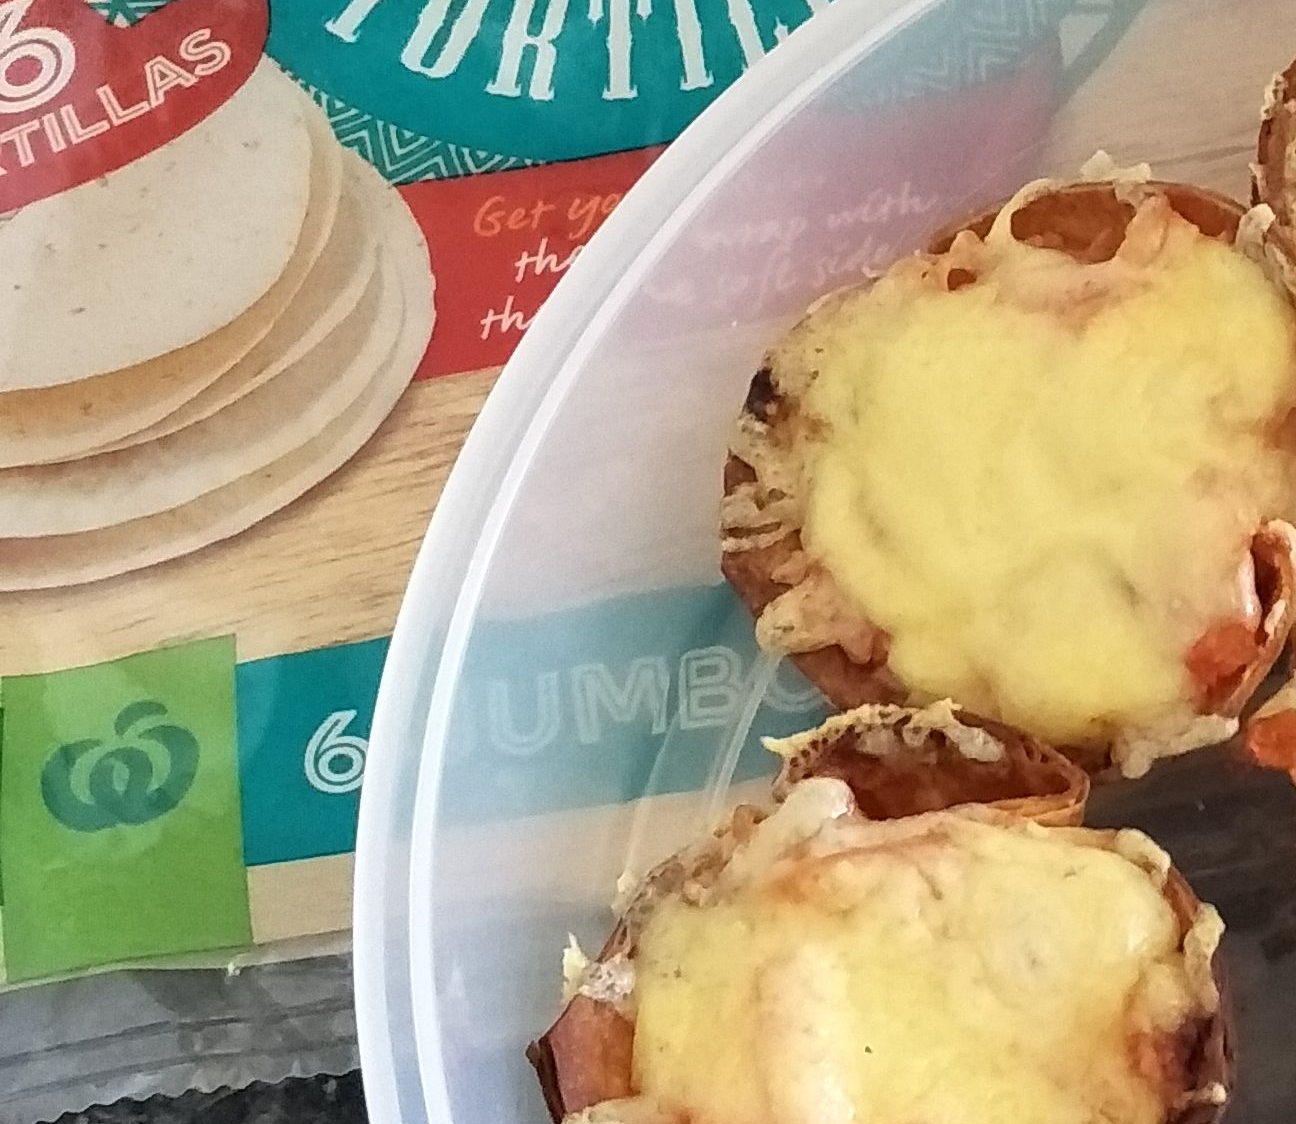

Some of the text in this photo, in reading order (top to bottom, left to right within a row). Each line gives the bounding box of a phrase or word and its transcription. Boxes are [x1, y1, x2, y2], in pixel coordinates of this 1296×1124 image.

[0, 27, 232, 175] TILLAS
[473, 195, 557, 237] Get
[567, 192, 624, 240] yo
[480, 295, 537, 341] th
[304, 709, 369, 795] 6
